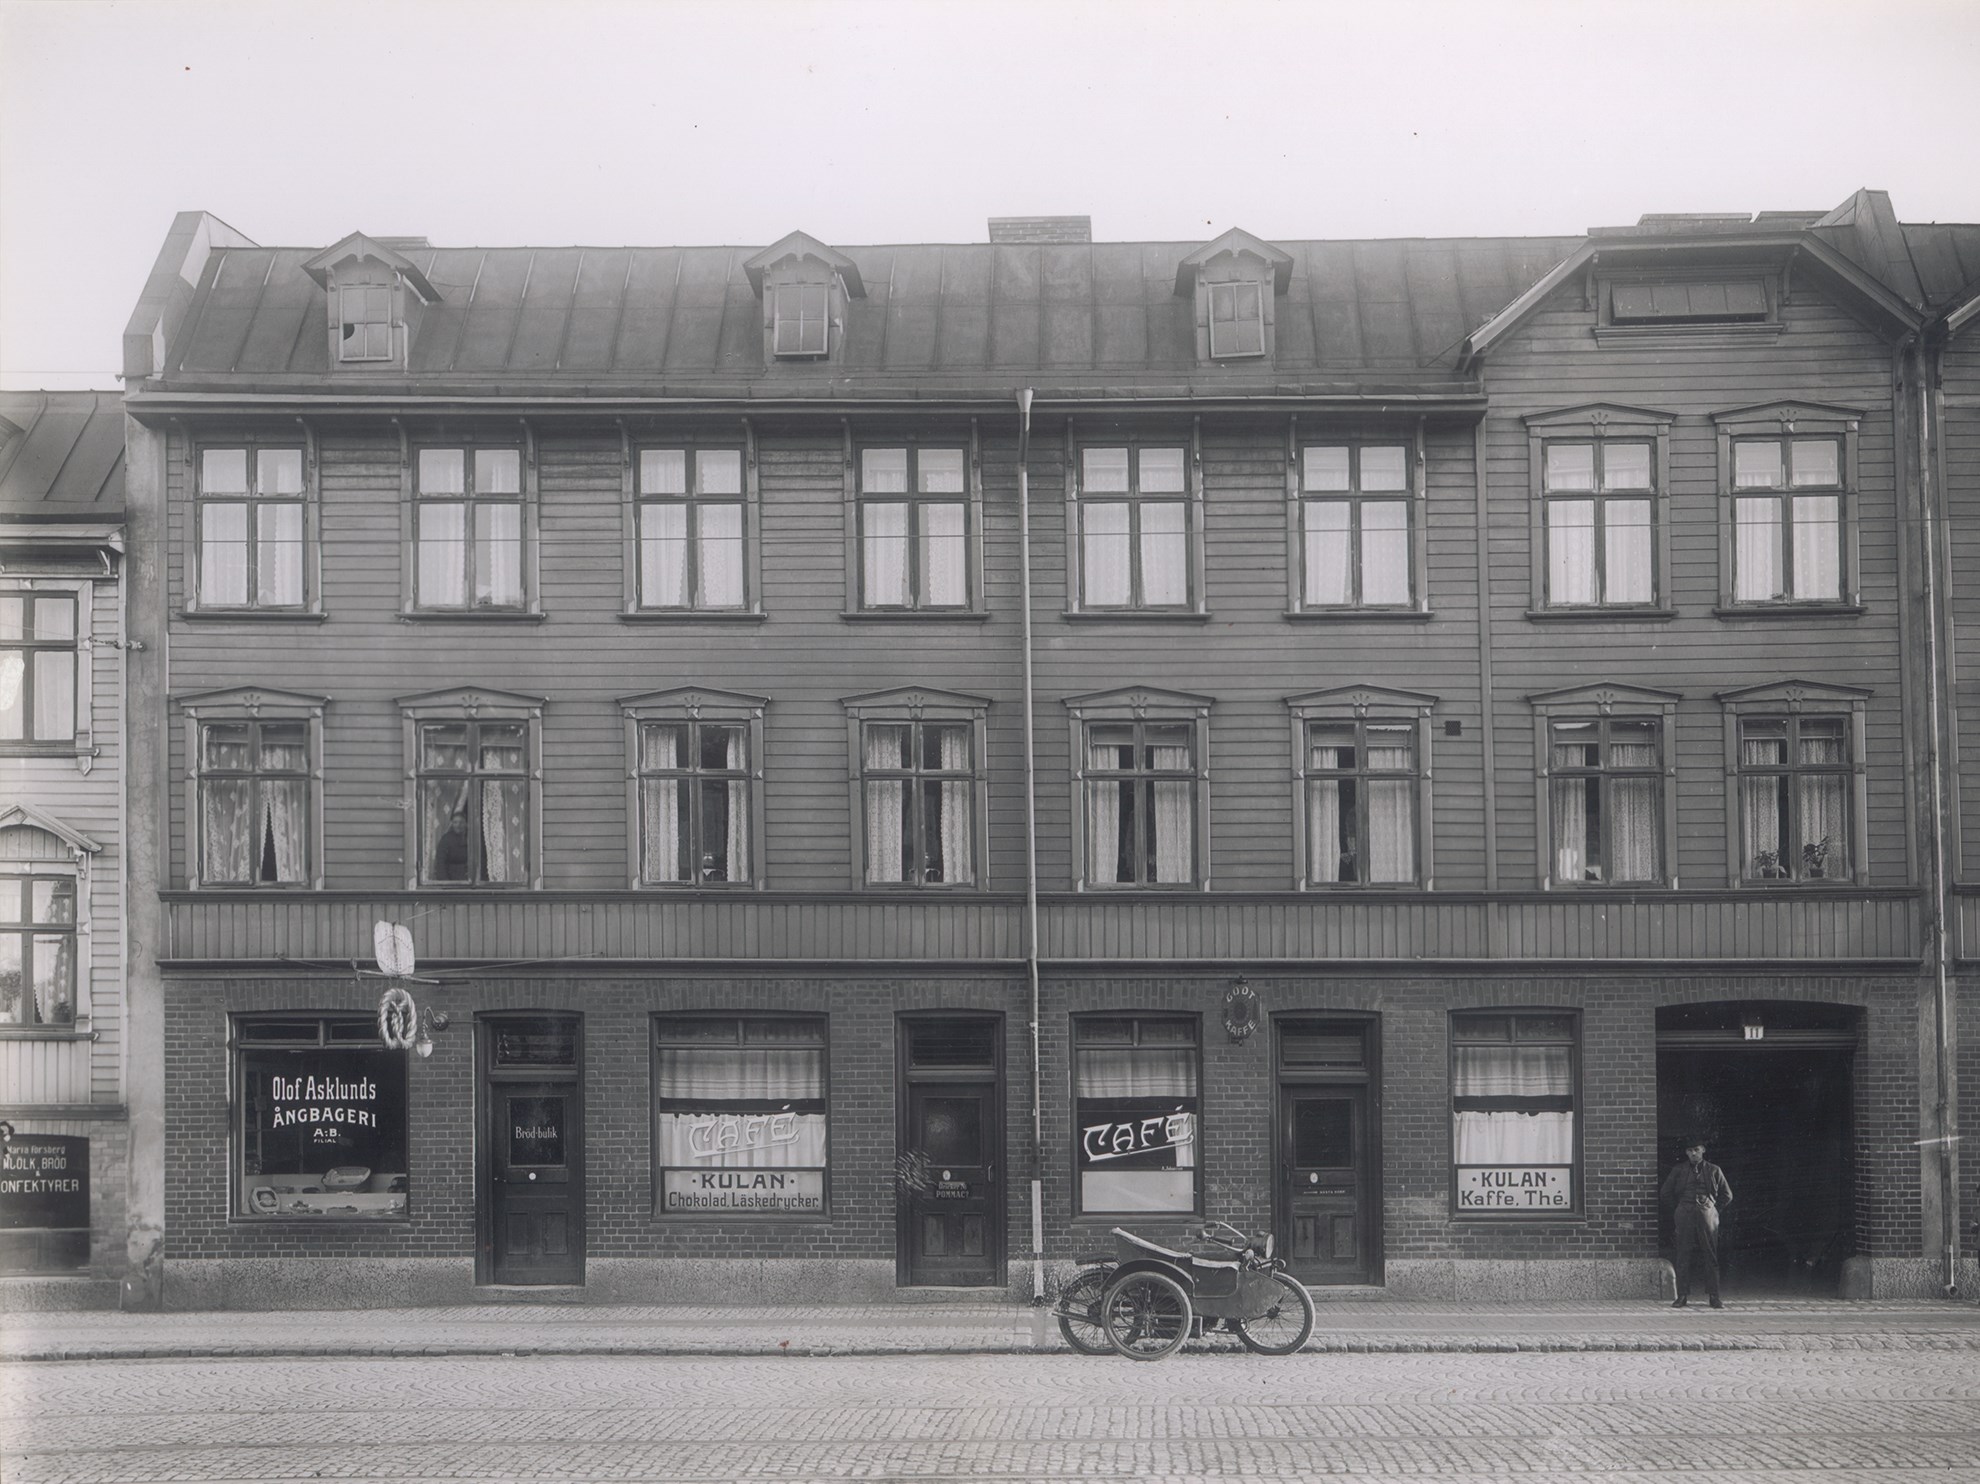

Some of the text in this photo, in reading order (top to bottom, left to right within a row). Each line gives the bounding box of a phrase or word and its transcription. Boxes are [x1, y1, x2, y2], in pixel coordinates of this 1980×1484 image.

[1225, 1019, 1256, 1036] KAFFE
[272, 1075, 377, 1101] Olof Asklunds
[273, 1106, 377, 1129] ÅNGBAGERI
[689, 1104, 800, 1159] CAFÉ
[1083, 1105, 1195, 1162] CAFÉ
[41, 1155, 67, 1170] BRÖD
[0, 1179, 80, 1193] ONFEKTYRER
[1461, 1190, 1568, 1207] Kaffe, Thé.
